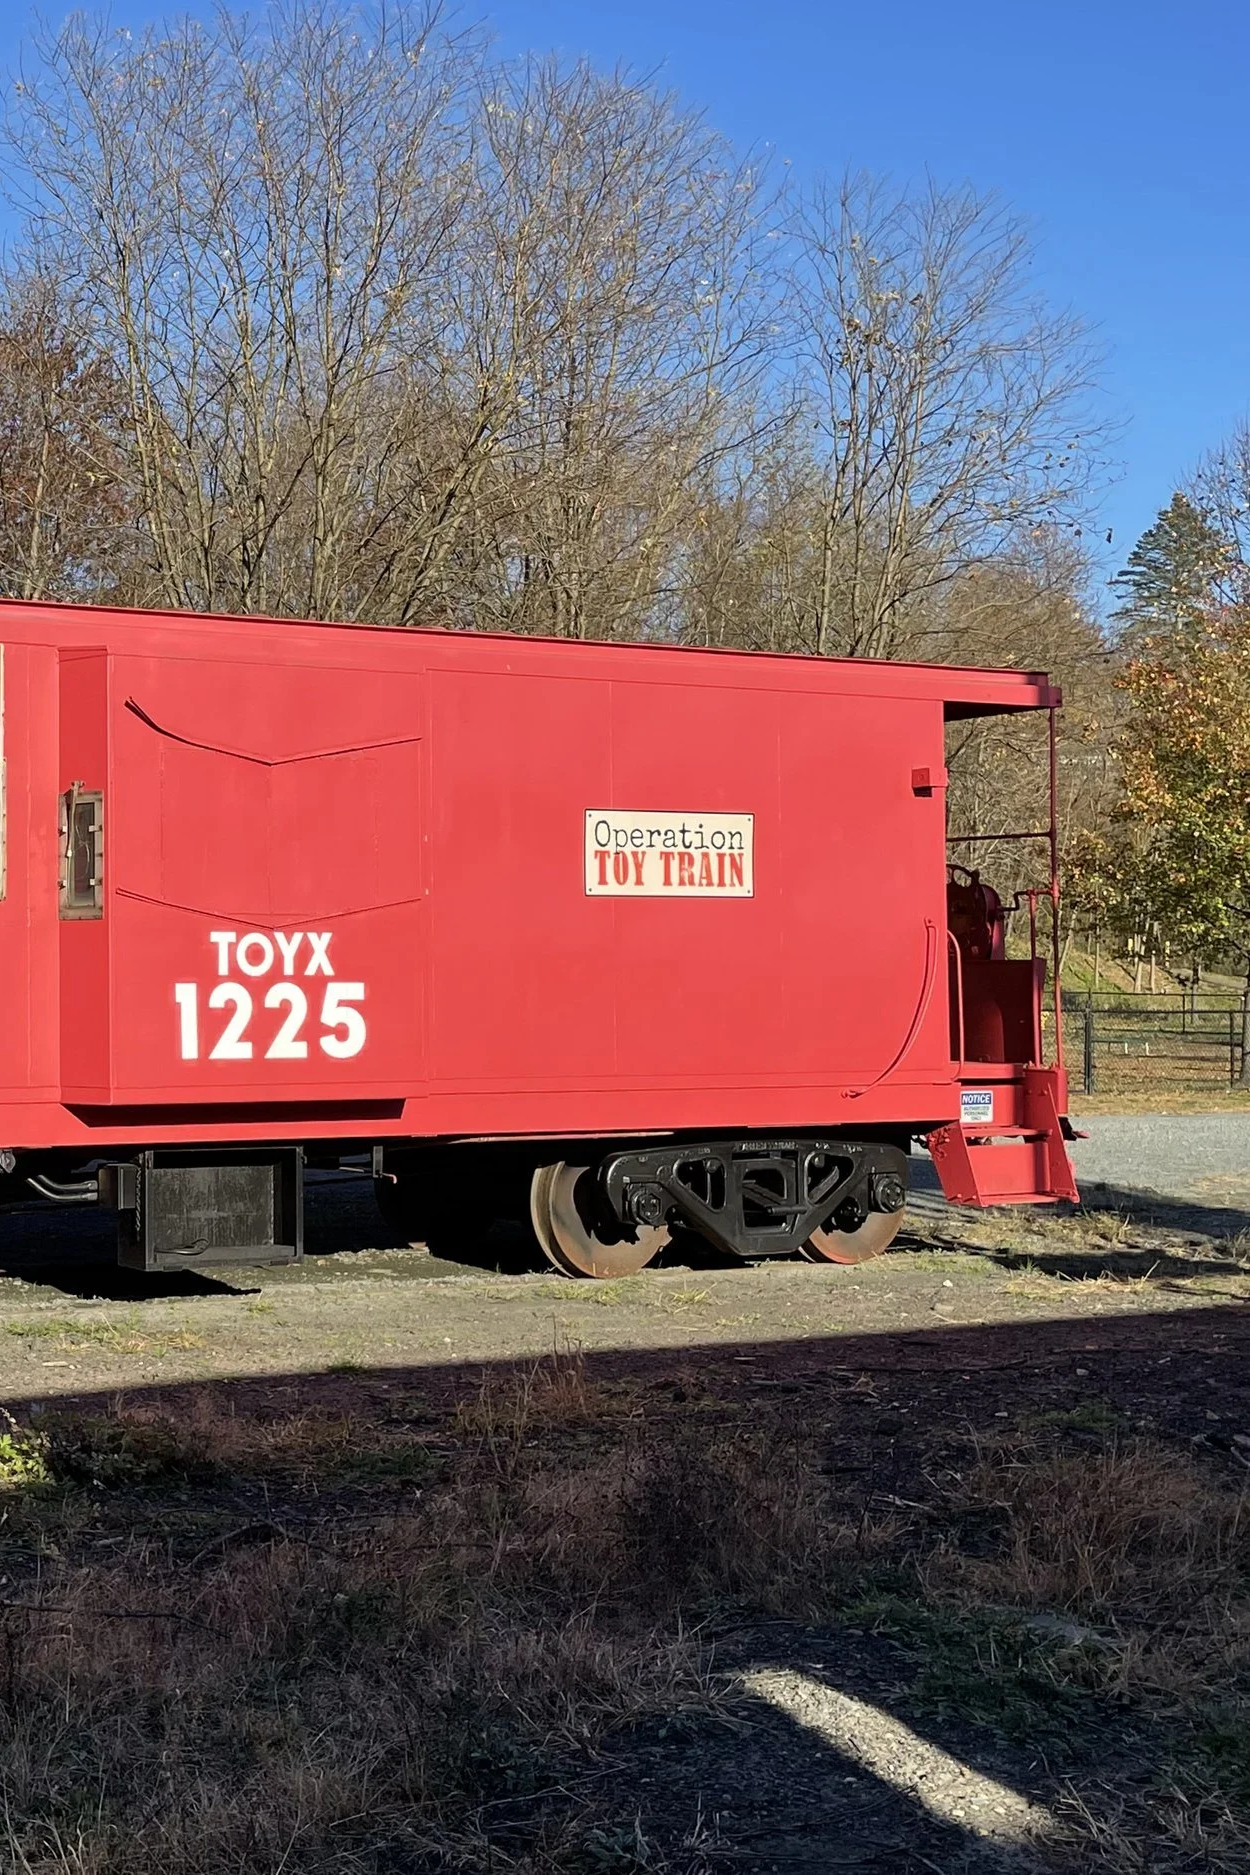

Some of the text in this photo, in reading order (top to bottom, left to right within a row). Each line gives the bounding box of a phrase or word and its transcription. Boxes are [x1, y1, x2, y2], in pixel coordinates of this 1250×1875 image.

[594, 820, 744, 855] Operation
[594, 850, 744, 887] TOY TRAIN
[210, 931, 335, 976] TOYX
[175, 981, 367, 1060] 1225
[962, 1094, 990, 1104] NOTICE
